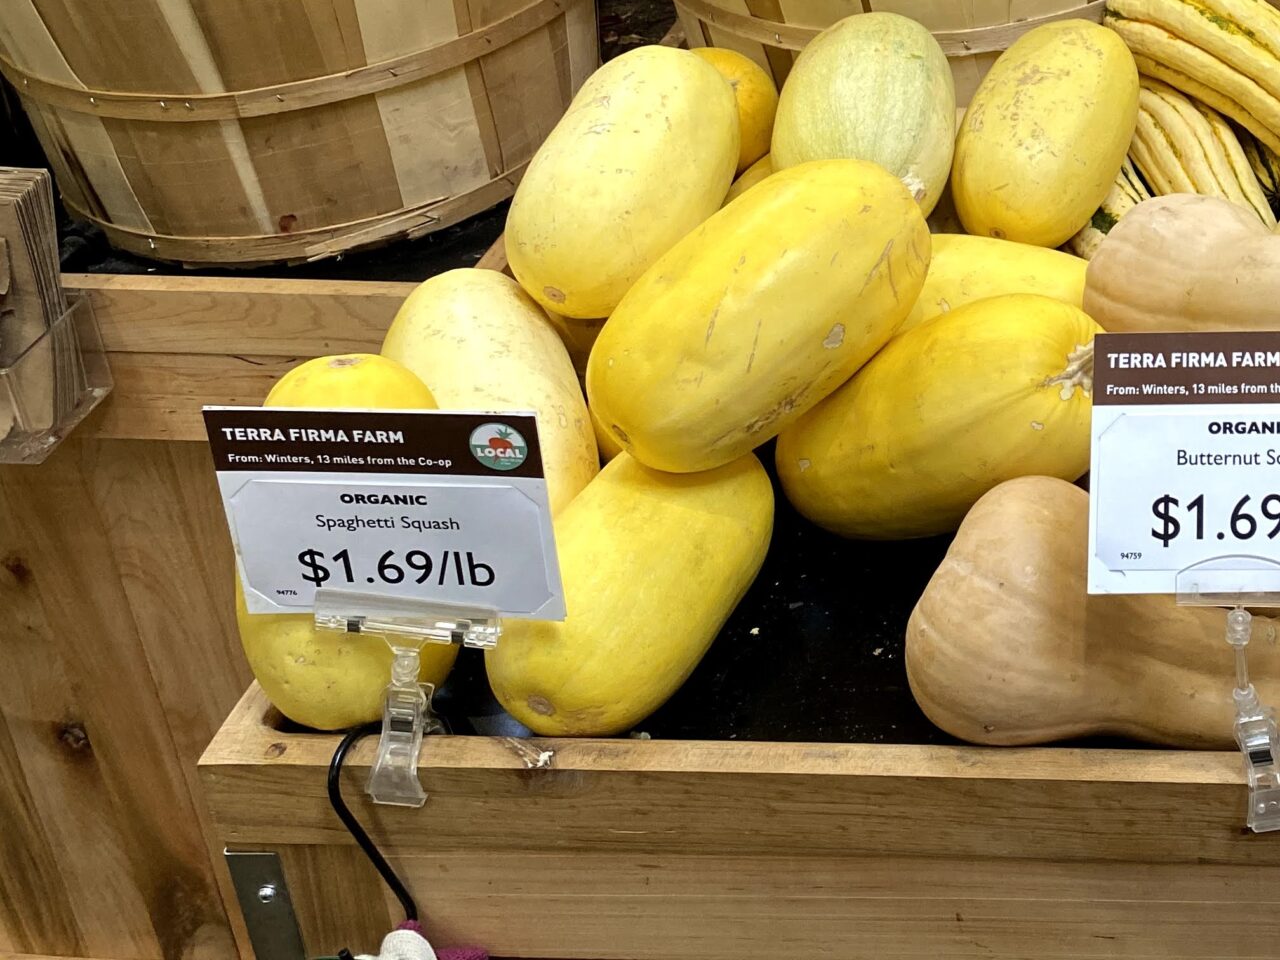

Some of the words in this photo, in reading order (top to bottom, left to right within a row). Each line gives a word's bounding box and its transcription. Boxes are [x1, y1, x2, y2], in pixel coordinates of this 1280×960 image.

[1107, 352, 1166, 369] TERRA
[1171, 352, 1228, 368] FIRMA
[1232, 351, 1280, 367] FARM
[1106, 384, 1140, 395] From:
[1142, 383, 1189, 397] Winters,
[1192, 384, 1205, 394] 13
[1208, 383, 1238, 394] miles
[1241, 383, 1267, 394] from
[221, 427, 286, 442] TERRA
[290, 428, 349, 443] FIRMA
[353, 429, 405, 445] FARM
[228, 453, 263, 464] From:
[264, 454, 315, 465] Winters,
[318, 454, 331, 465] 13
[333, 454, 365, 466] miles
[367, 455, 395, 466] from
[397, 456, 417, 467] the
[418, 457, 452, 469] Co-op
[476, 447, 524, 459] LOCAL
[1177, 449, 1260, 466] Butternut
[340, 493, 428, 506] ORGANIC
[315, 514, 395, 532] Spaghetti
[401, 516, 460, 532] Squash
[1120, 552, 1142, 561] 94759
[297, 548, 496, 588] $1.69/lb
